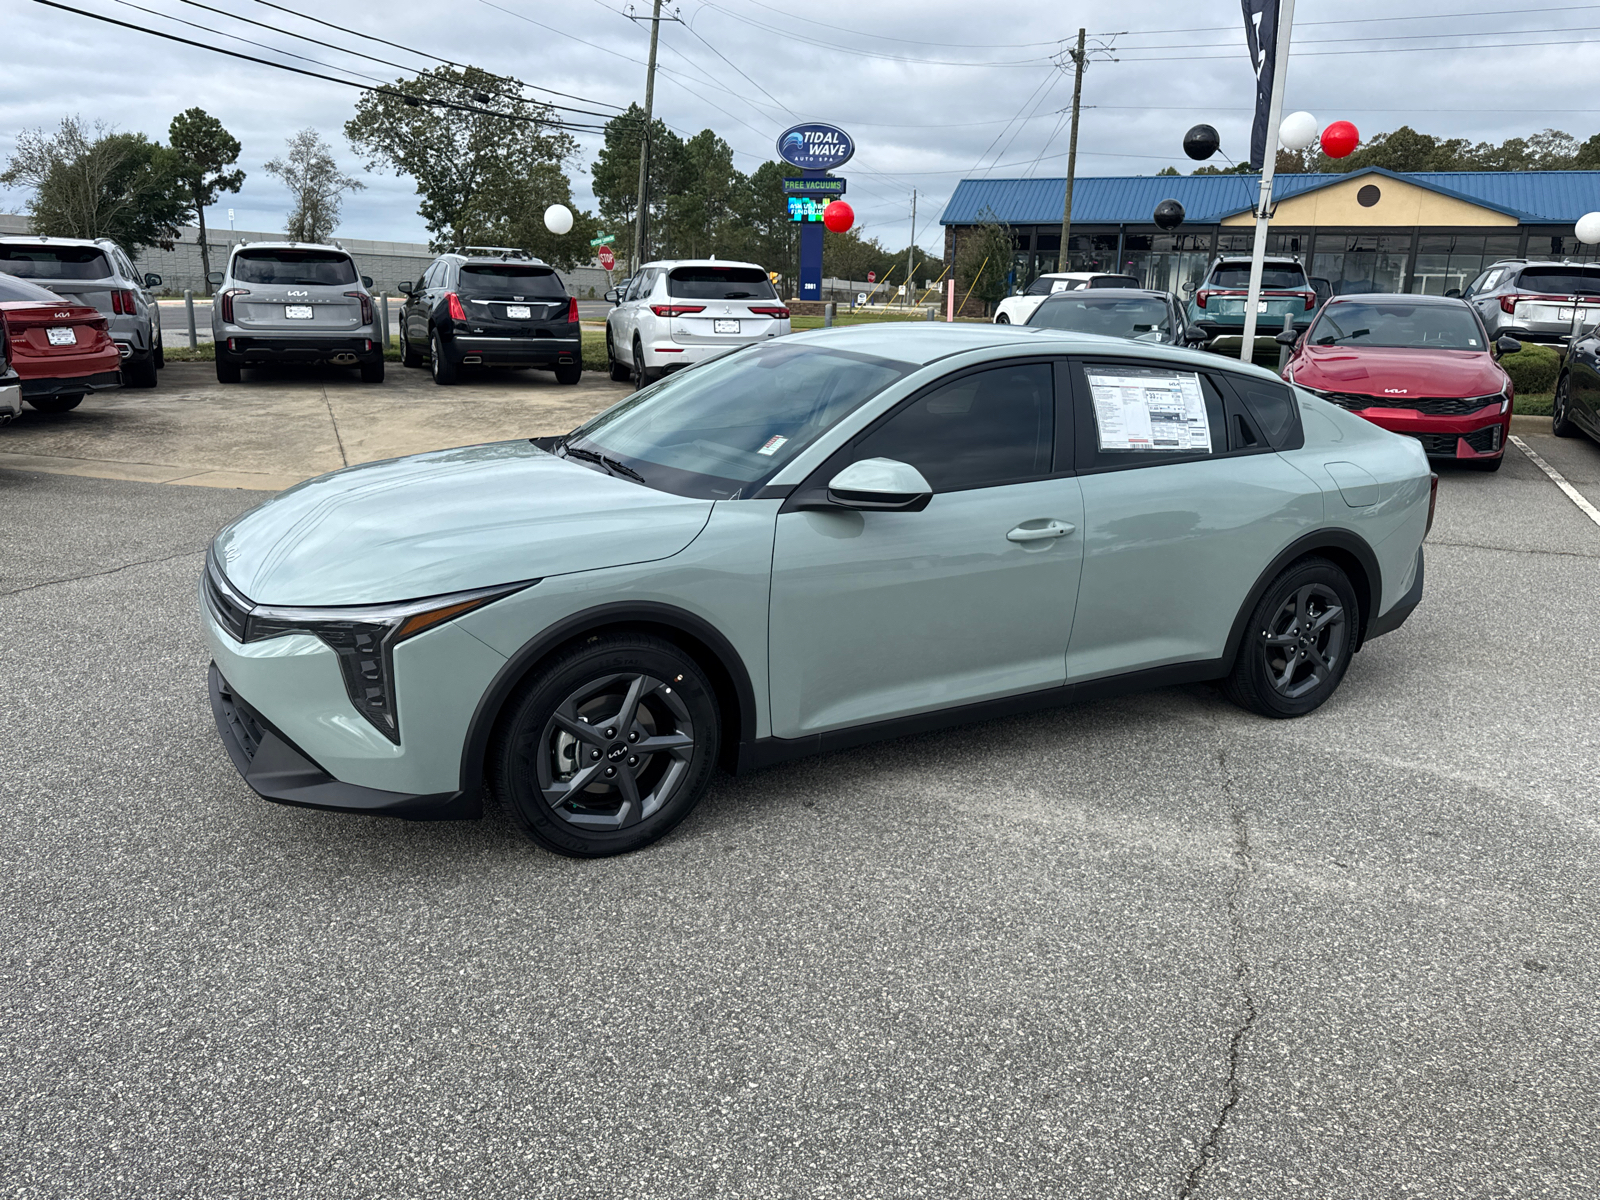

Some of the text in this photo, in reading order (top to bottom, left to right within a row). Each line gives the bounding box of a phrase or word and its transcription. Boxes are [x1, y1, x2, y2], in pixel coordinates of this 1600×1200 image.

[804, 132, 839, 143] TIDAL
[809, 144, 847, 156] WAVE
[806, 181, 841, 189] VACUUMS
[600, 253, 613, 263] STOP
[608, 746, 627, 758] KIA
